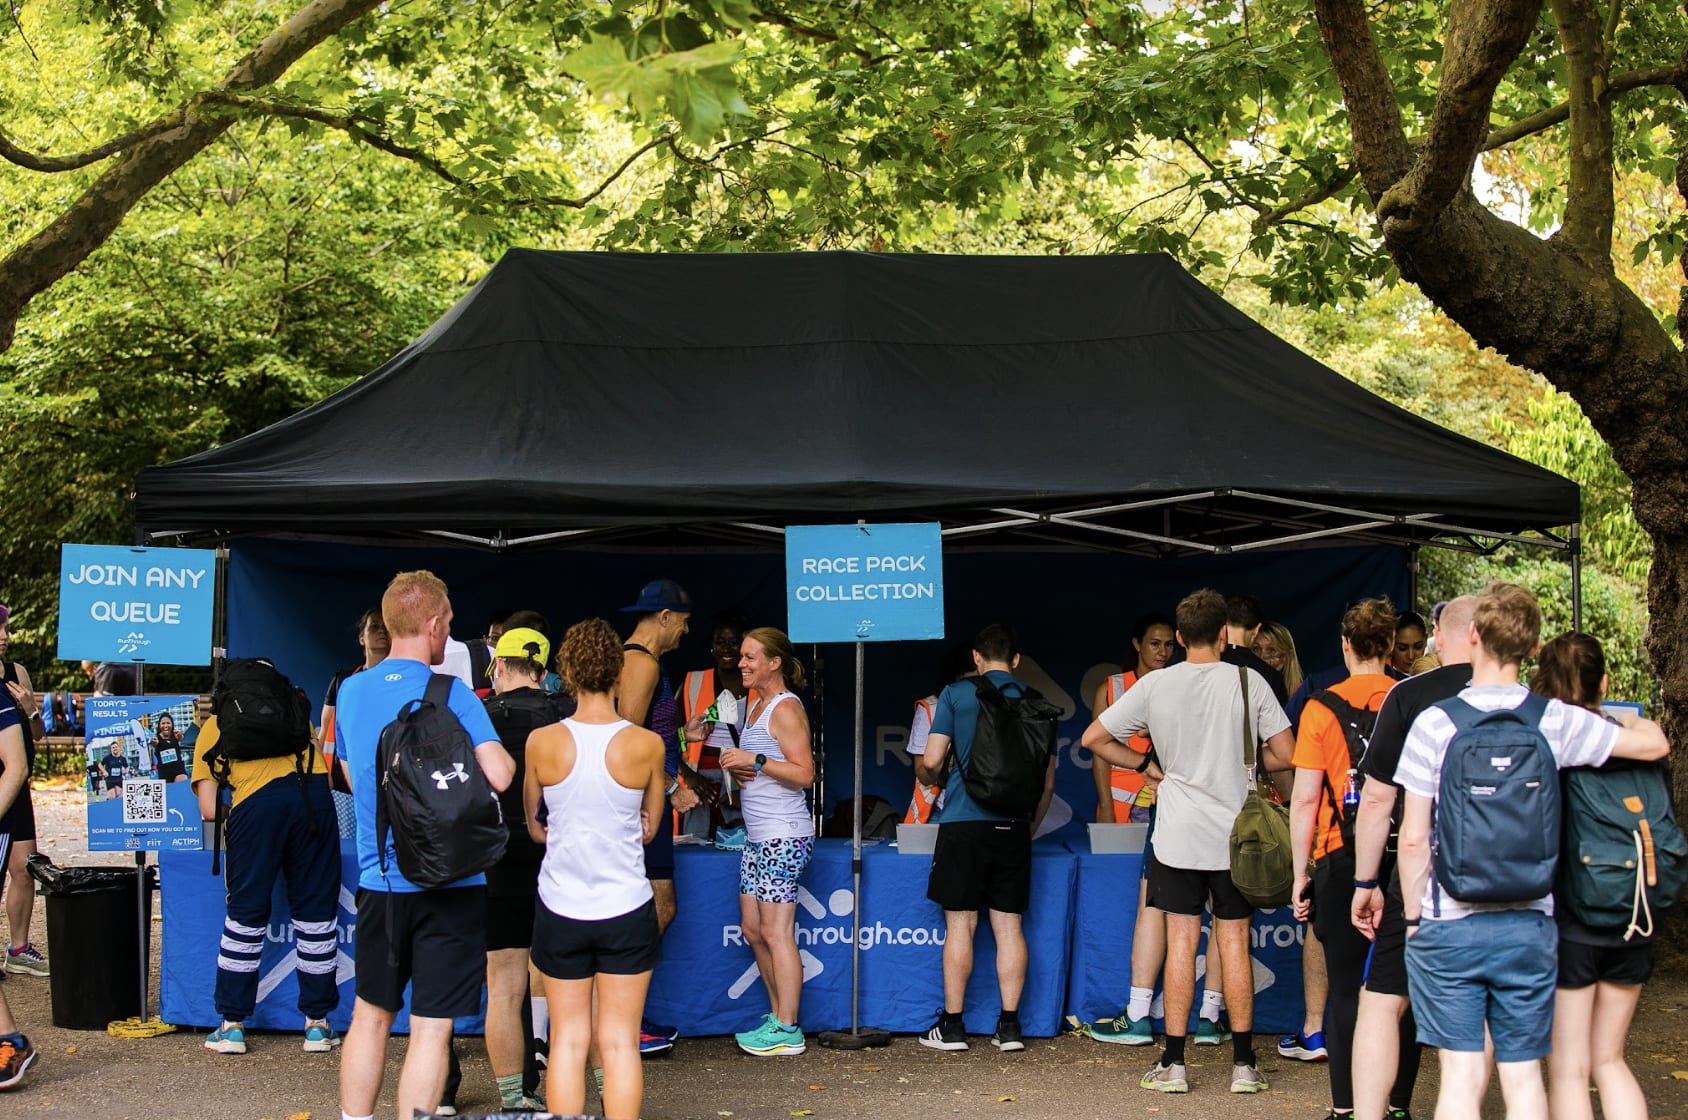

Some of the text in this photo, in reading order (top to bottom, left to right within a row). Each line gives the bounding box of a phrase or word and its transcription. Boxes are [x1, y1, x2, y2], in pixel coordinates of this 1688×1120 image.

[802, 555, 926, 574] RACE PACK
[69, 564, 206, 589] JOIN ANY
[796, 582, 934, 601] COLLECTION
[91, 600, 181, 625] QUEUE
[94, 725, 130, 736] FINISH
